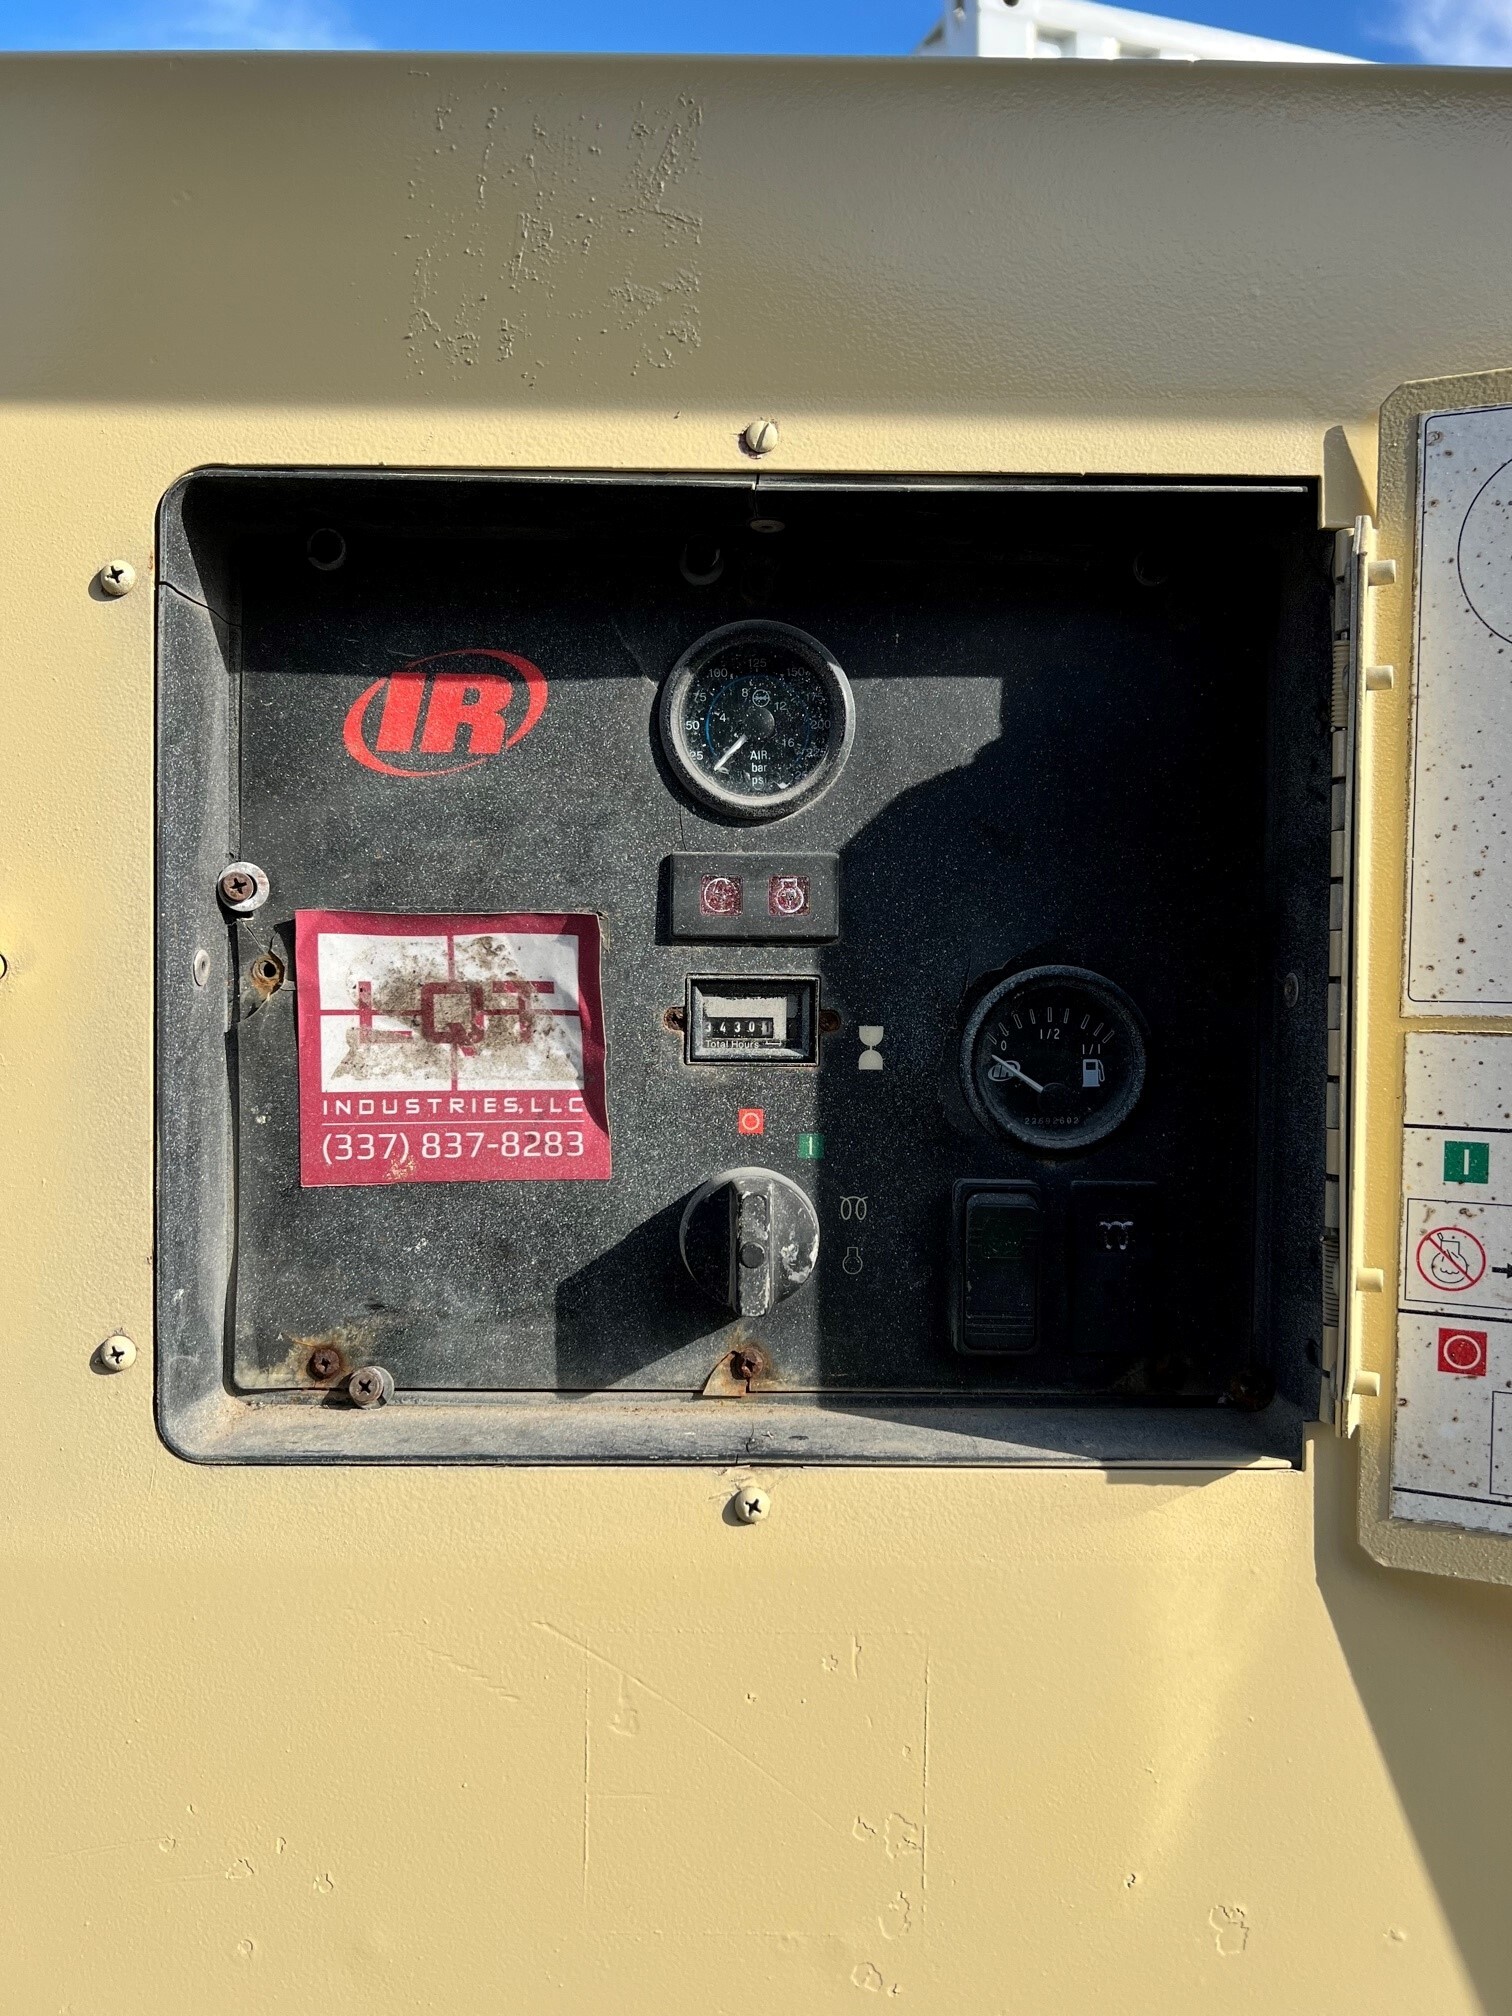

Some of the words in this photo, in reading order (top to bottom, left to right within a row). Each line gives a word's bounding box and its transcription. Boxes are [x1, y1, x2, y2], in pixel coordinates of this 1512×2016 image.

[748, 658, 767, 668] 125
[709, 667, 729, 678] 100
[786, 667, 806, 677] 150
[694, 692, 707, 703] 75
[741, 687, 749, 698] 8
[774, 701, 787, 711] 12
[375, 671, 514, 755] IR
[719, 712, 727, 723] 4
[685, 720, 700, 731] 50
[810, 720, 832, 730] 200
[782, 738, 795, 748] 16
[690, 751, 704, 761] 25
[751, 762, 767, 773] bar
[751, 775, 768, 787] psi
[1039, 1028, 1060, 1040] 1/2
[705, 1039, 729, 1049] Total
[731, 1040, 760, 1049] Hours
[1000, 1039, 1007, 1051] 0
[1082, 1043, 1101, 1055] 1/1
[322, 1132, 410, 1165] (337)
[421, 1130, 585, 1160] 837-8283
